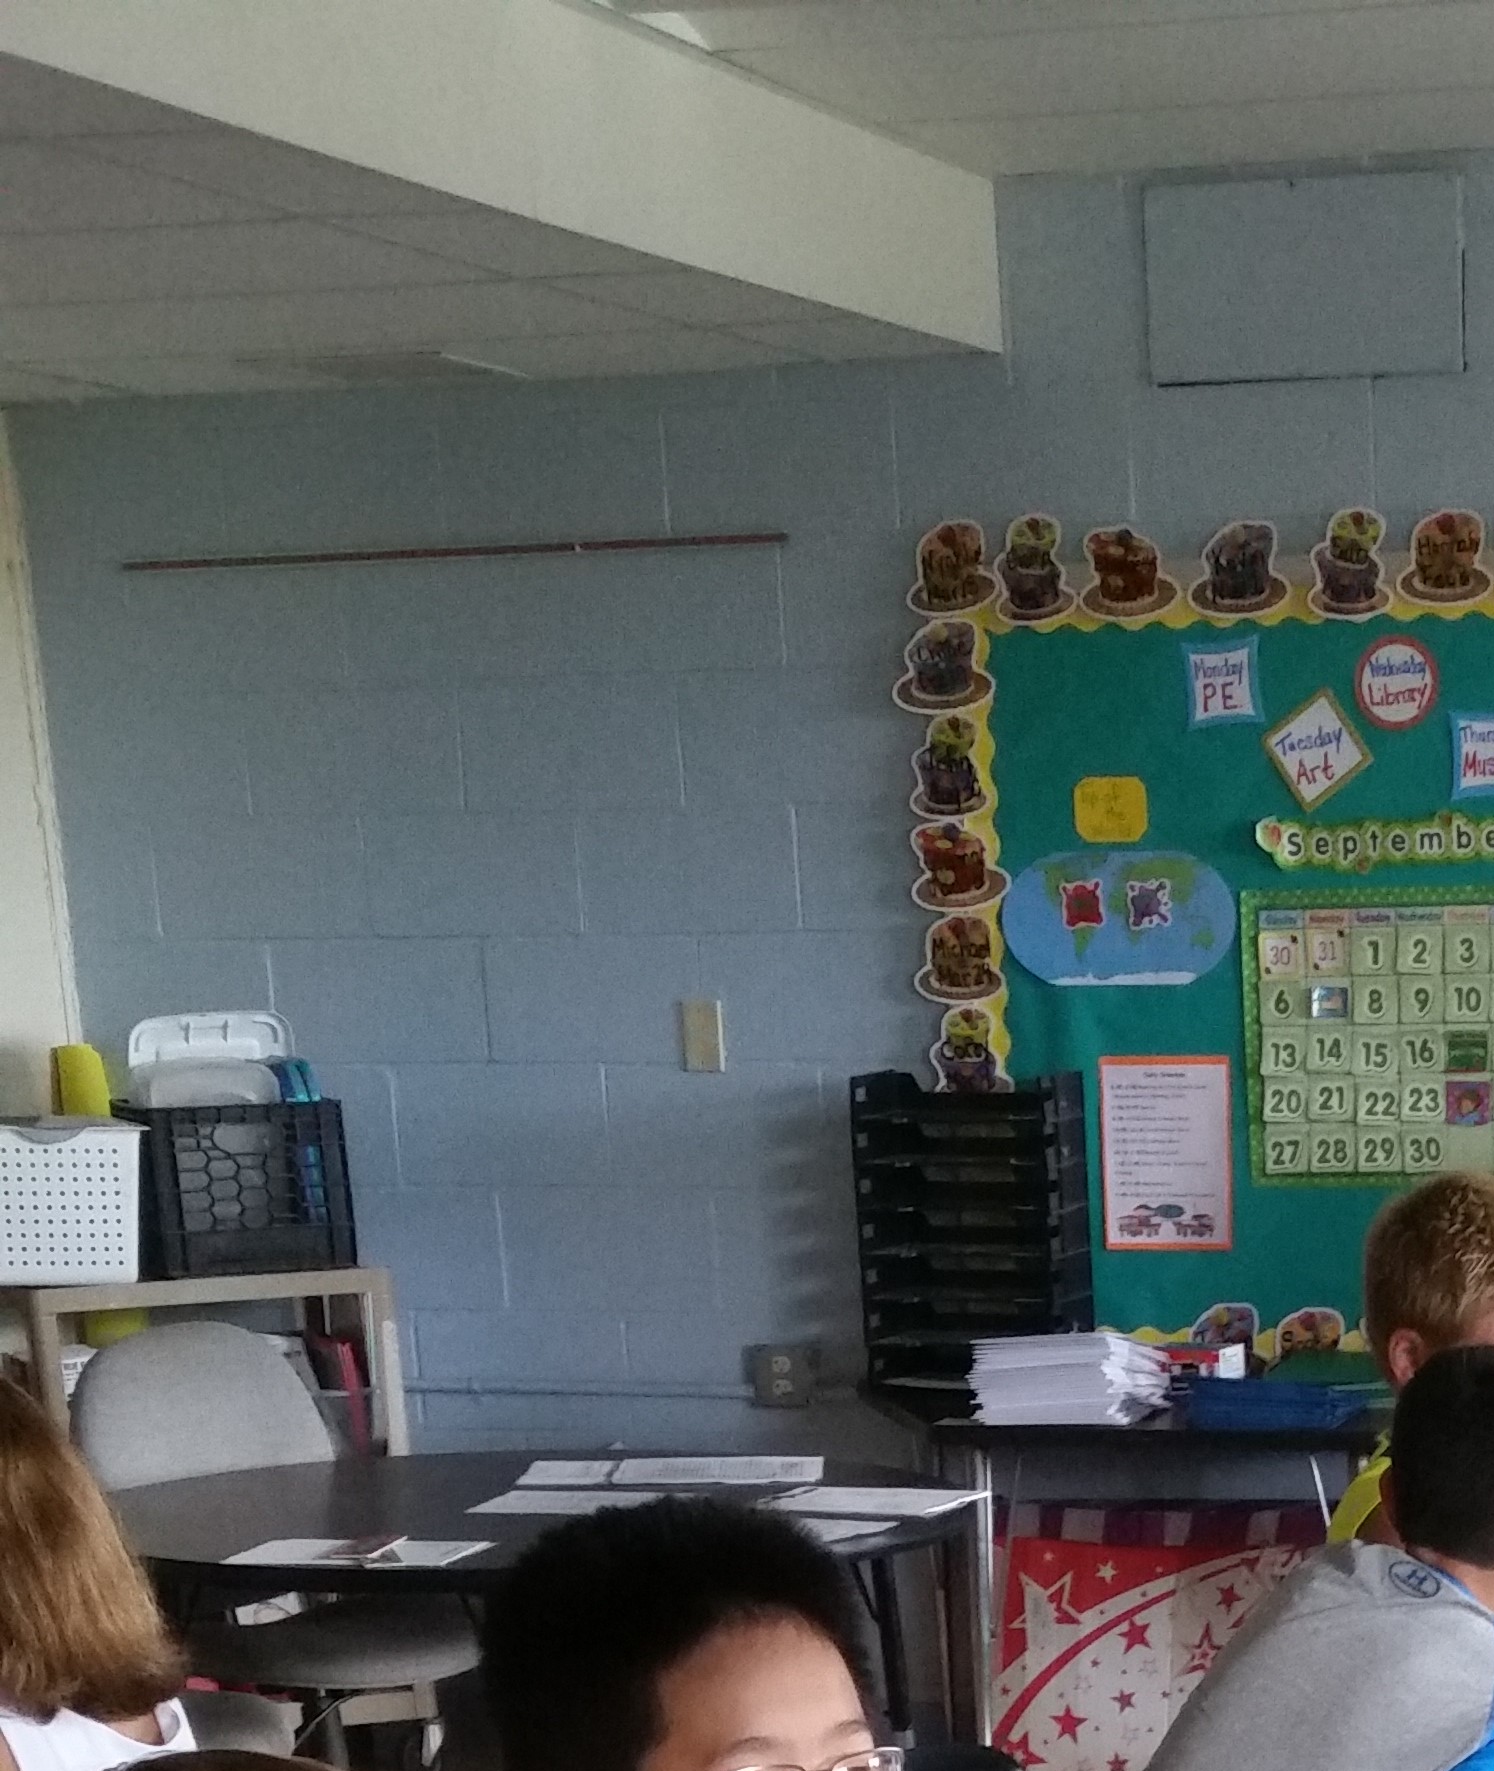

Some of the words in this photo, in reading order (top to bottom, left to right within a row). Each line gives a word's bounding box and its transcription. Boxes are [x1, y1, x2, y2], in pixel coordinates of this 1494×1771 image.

[1193, 657, 1244, 686] Monday
[1366, 681, 1428, 709] Library
[1275, 726, 1344, 757] Tuesday
[1295, 755, 1336, 786] Art
[1269, 944, 1290, 966] 30
[1318, 940, 1337, 962] 31
[1366, 940, 1380, 966] 1
[1412, 938, 1429, 964] 2
[1459, 937, 1475, 963] 3
[1274, 989, 1290, 1014] 6
[1368, 988, 1383, 1014] 8
[1414, 987, 1430, 1013] 9
[1454, 986, 1481, 1012] 10
[1270, 1042, 1297, 1068] 13
[1316, 1037, 1343, 1063] 14
[1362, 1043, 1388, 1069] 15
[1406, 1039, 1434, 1064] 16
[1271, 1089, 1301, 1114] 20
[1318, 1086, 1345, 1111] 21
[1364, 1092, 1396, 1117] 22
[1408, 1087, 1440, 1112] 23
[1271, 1140, 1300, 1165] 27
[1317, 1138, 1347, 1164] 28
[1363, 1137, 1394, 1162] 29
[1409, 1136, 1440, 1161] 30
